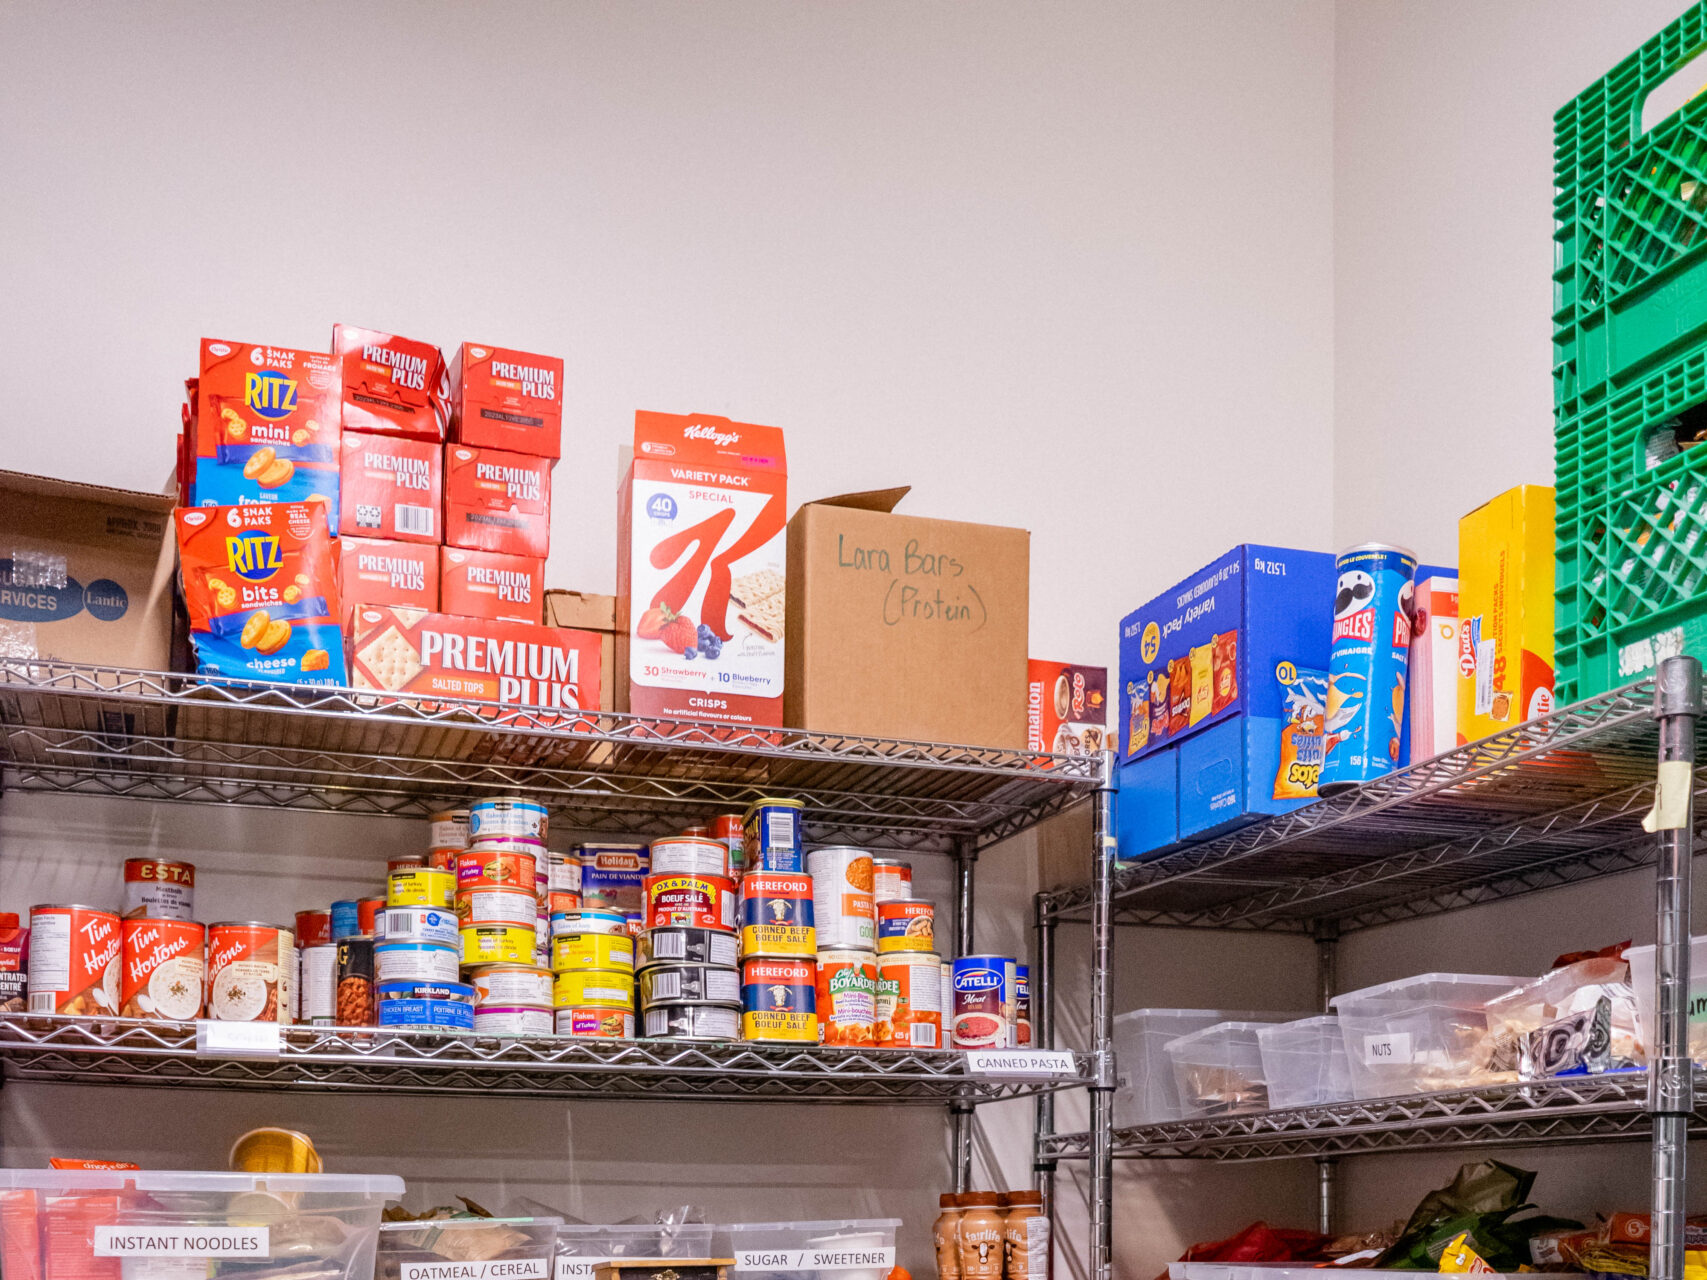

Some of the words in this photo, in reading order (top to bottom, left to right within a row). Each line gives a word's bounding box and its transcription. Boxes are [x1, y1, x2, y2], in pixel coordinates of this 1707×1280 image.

[250, 347, 264, 366] 6
[266, 349, 295, 361] SNAK
[266, 358, 293, 369] PAKS
[362, 343, 428, 375] PREMIUM
[391, 367, 425, 391] PLUS
[491, 360, 555, 385] PREMIUM
[245, 371, 299, 412] RITZ
[522, 381, 555, 400] PLUS
[251, 423, 290, 441] mini
[684, 424, 741, 446] Kellogg's
[249, 436, 291, 447] sandwiches
[363, 452, 430, 475] PREMIUM
[396, 471, 430, 491] PLUS
[476, 462, 540, 486] PREMIUM
[670, 467, 717, 484] VARIETY
[718, 473, 749, 487] PACK
[507, 482, 541, 501] PLUS
[688, 489, 735, 505] SPECIAL
[652, 496, 672, 513] 40
[226, 508, 242, 528] 6
[242, 506, 273, 518] SNAK
[244, 516, 272, 527] PAKS
[225, 535, 284, 574] RITZ
[838, 533, 891, 574] Lara
[904, 538, 964, 577] Bars
[358, 554, 425, 576] PREMIUM
[1253, 557, 1266, 573] kg
[1266, 560, 1287, 576] 1.512
[390, 571, 425, 591] PLUS
[467, 565, 531, 589] PREMIUM
[0, 588, 58, 611] RVICES
[85, 591, 125, 609] Lantic
[242, 586, 279, 602] bits
[497, 585, 532, 604] PLUS
[240, 599, 283, 609] sandwiches
[882, 578, 988, 635] (Protein)
[1184, 596, 1215, 624] Variety
[1162, 615, 1184, 639] Pack
[1144, 635, 1156, 659] 54
[246, 657, 297, 670] cheese
[420, 629, 580, 684] PREMIUM
[643, 665, 659, 678] 30
[660, 665, 707, 679] Strawberry
[717, 671, 731, 684] 10
[731, 672, 772, 686] Blueberry
[1278, 666, 1294, 681] 10
[1494, 655, 1508, 692] 48
[431, 677, 462, 692] SALTED
[463, 680, 485, 694] TOPS
[1071, 672, 1086, 713] Rolo
[498, 675, 580, 719] PLUS
[688, 696, 728, 710] CRISPS
[663, 707, 672, 716] No
[672, 708, 698, 719] artificial
[697, 711, 722, 721] flavours
[730, 713, 753, 723] colours
[1349, 755, 1362, 767] 156
[459, 859, 477, 868] Flakes
[600, 856, 636, 867] Holiday
[140, 864, 192, 885] ESTA
[656, 882, 670, 892] OX
[680, 880, 709, 892] PALM
[750, 881, 808, 893] HEREFORD
[661, 894, 685, 903] BOEUF
[686, 892, 703, 903] SALÉ
[852, 901, 869, 909] PASTA
[80, 918, 112, 945] Tim
[128, 926, 160, 953] Tim
[752, 926, 786, 935] CORNED
[790, 926, 810, 936] BEEF
[755, 935, 784, 943] BOEUF
[83, 938, 120, 975] Horton
[129, 936, 184, 983] Hortons
[751, 966, 809, 978] HEREFORD
[954, 975, 998, 989] CATELLI
[414, 987, 450, 995] KIRKLAND
[962, 993, 987, 1006] Meat
[402, 1005, 423, 1013] BREAST
[433, 1006, 456, 1014] POITRINE
[573, 1012, 595, 1021] Flakes
[752, 1012, 787, 1022] CORNED
[789, 1012, 811, 1022] BEEF
[754, 1020, 785, 1029] BOEUF
[1371, 1041, 1393, 1058] NUTS
[976, 1057, 1029, 1070] CANNED
[1031, 1058, 1069, 1070] PASTA
[108, 1236, 180, 1252] INSTANT
[183, 1236, 260, 1252] NOODLES
[964, 1228, 1001, 1243] fairlife
[743, 1252, 789, 1267] SUGAR
[812, 1251, 887, 1266] SWEETENER
[408, 1265, 477, 1280] OATMEAL
[479, 1263, 488, 1280] /
[490, 1261, 541, 1277] CEREAL
[561, 1263, 597, 1277] INSTA
